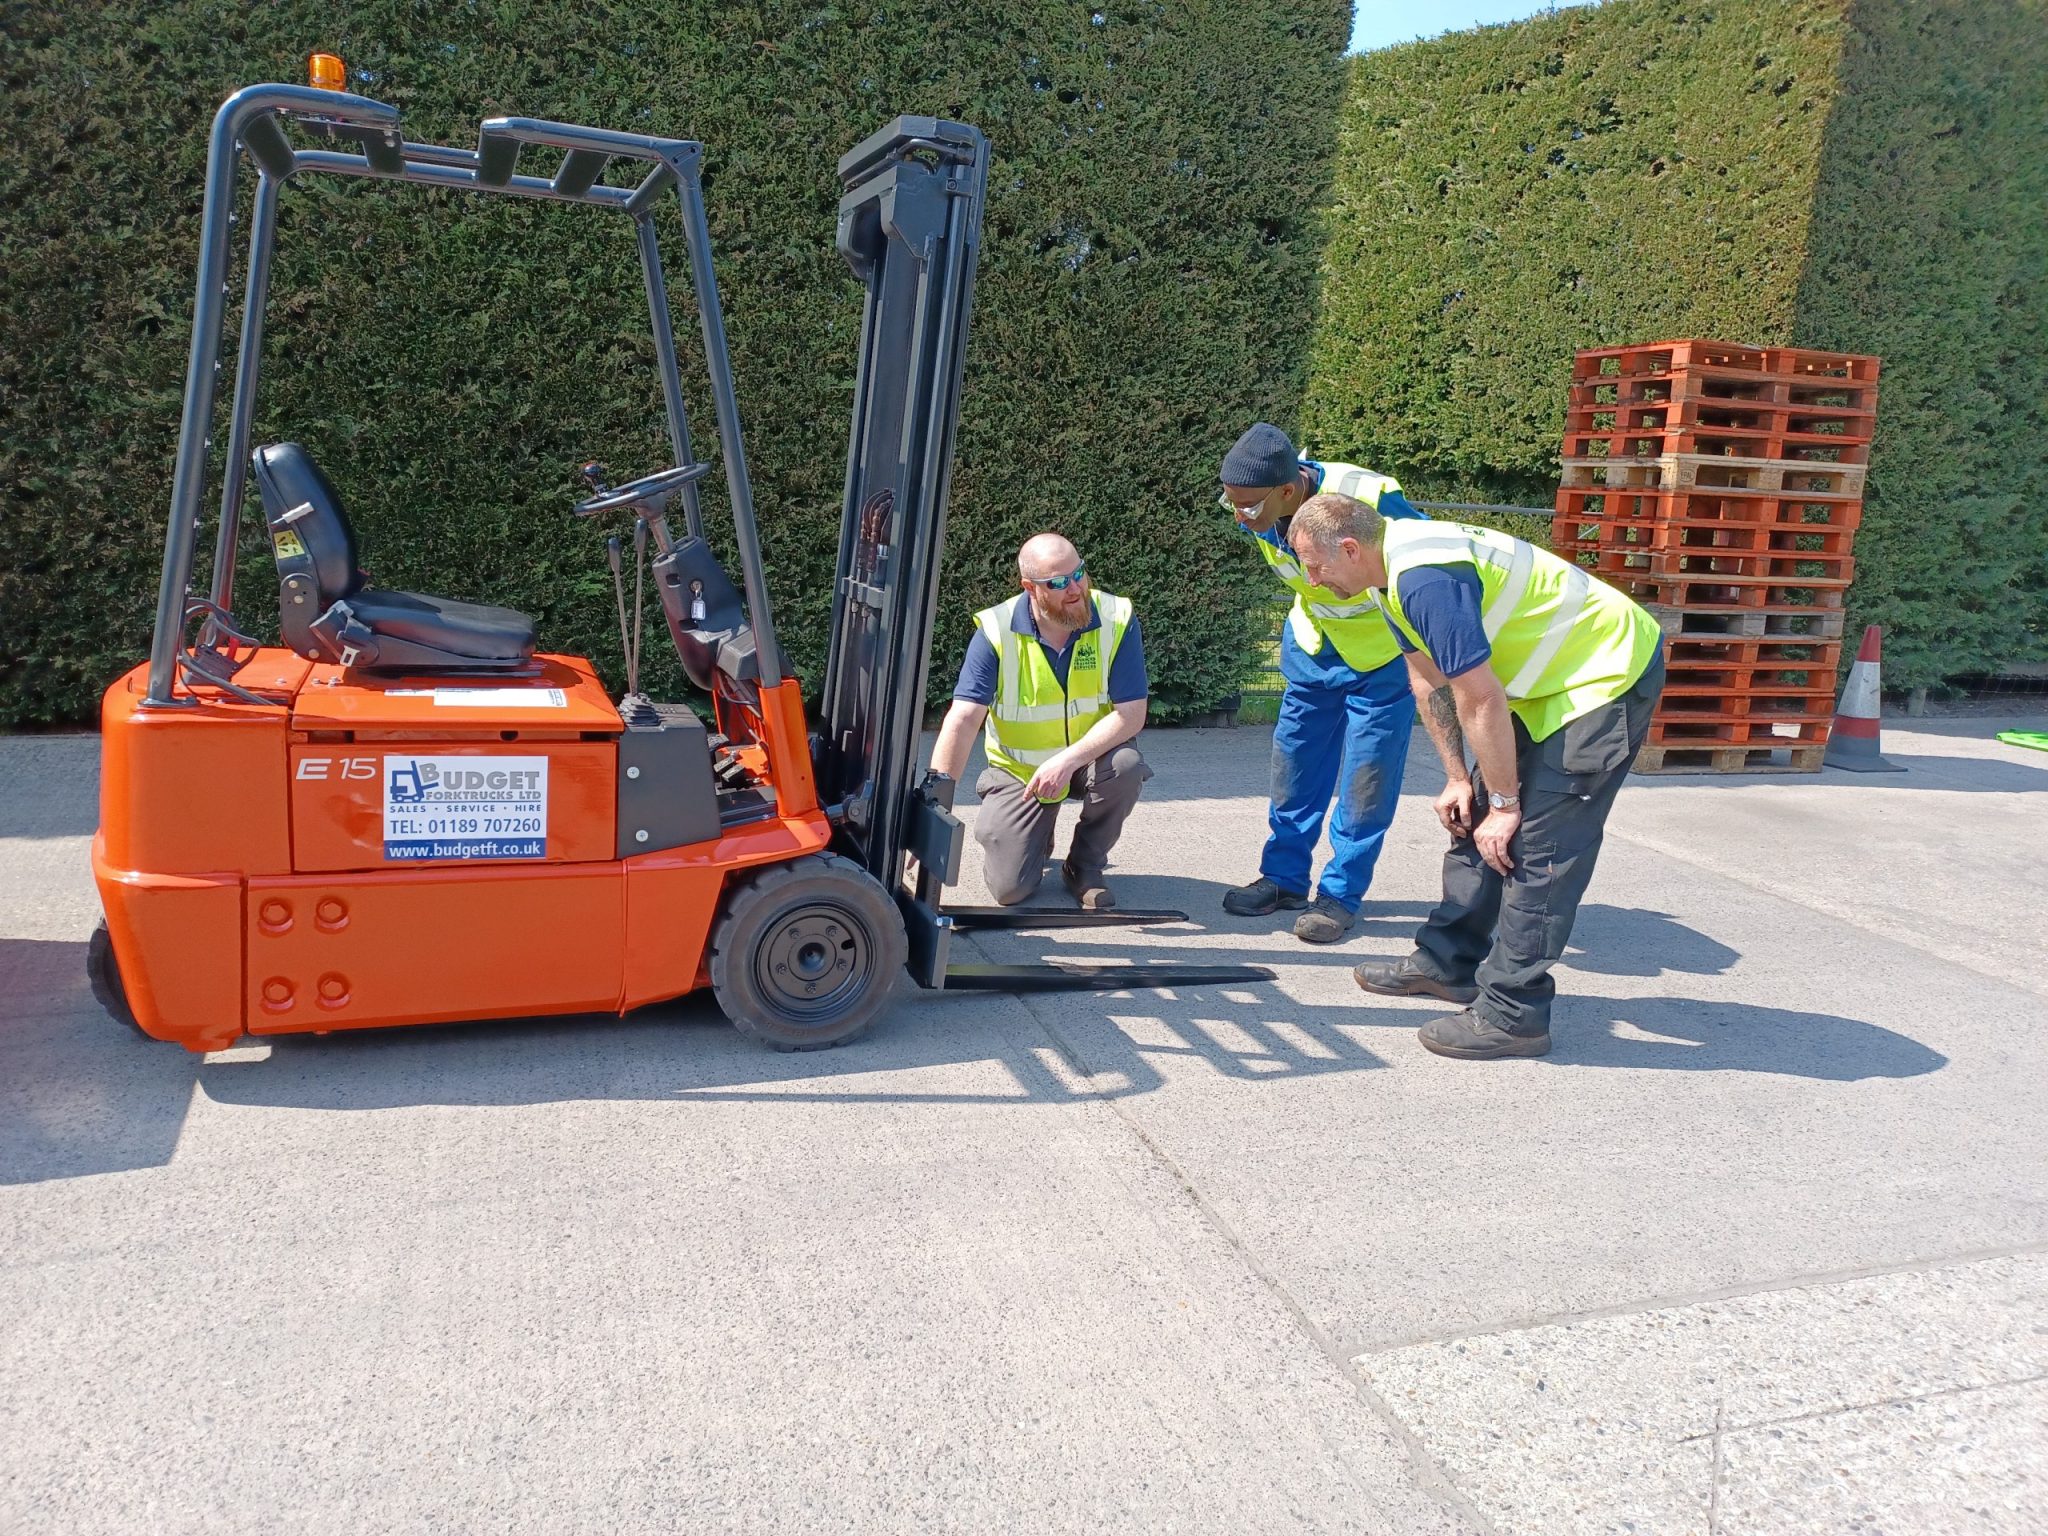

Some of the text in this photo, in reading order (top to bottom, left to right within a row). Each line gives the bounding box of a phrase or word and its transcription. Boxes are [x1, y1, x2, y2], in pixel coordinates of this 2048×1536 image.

[296, 758, 377, 780] E 15
[419, 763, 540, 790] BUDGET
[426, 791, 541, 800] FORKTRUCKS LTD
[390, 804, 542, 813] SALES SERVICE HIRE
[390, 818, 541, 834] TEL: 01189 707260
[389, 841, 541, 859] www.budgetft.co.uk
